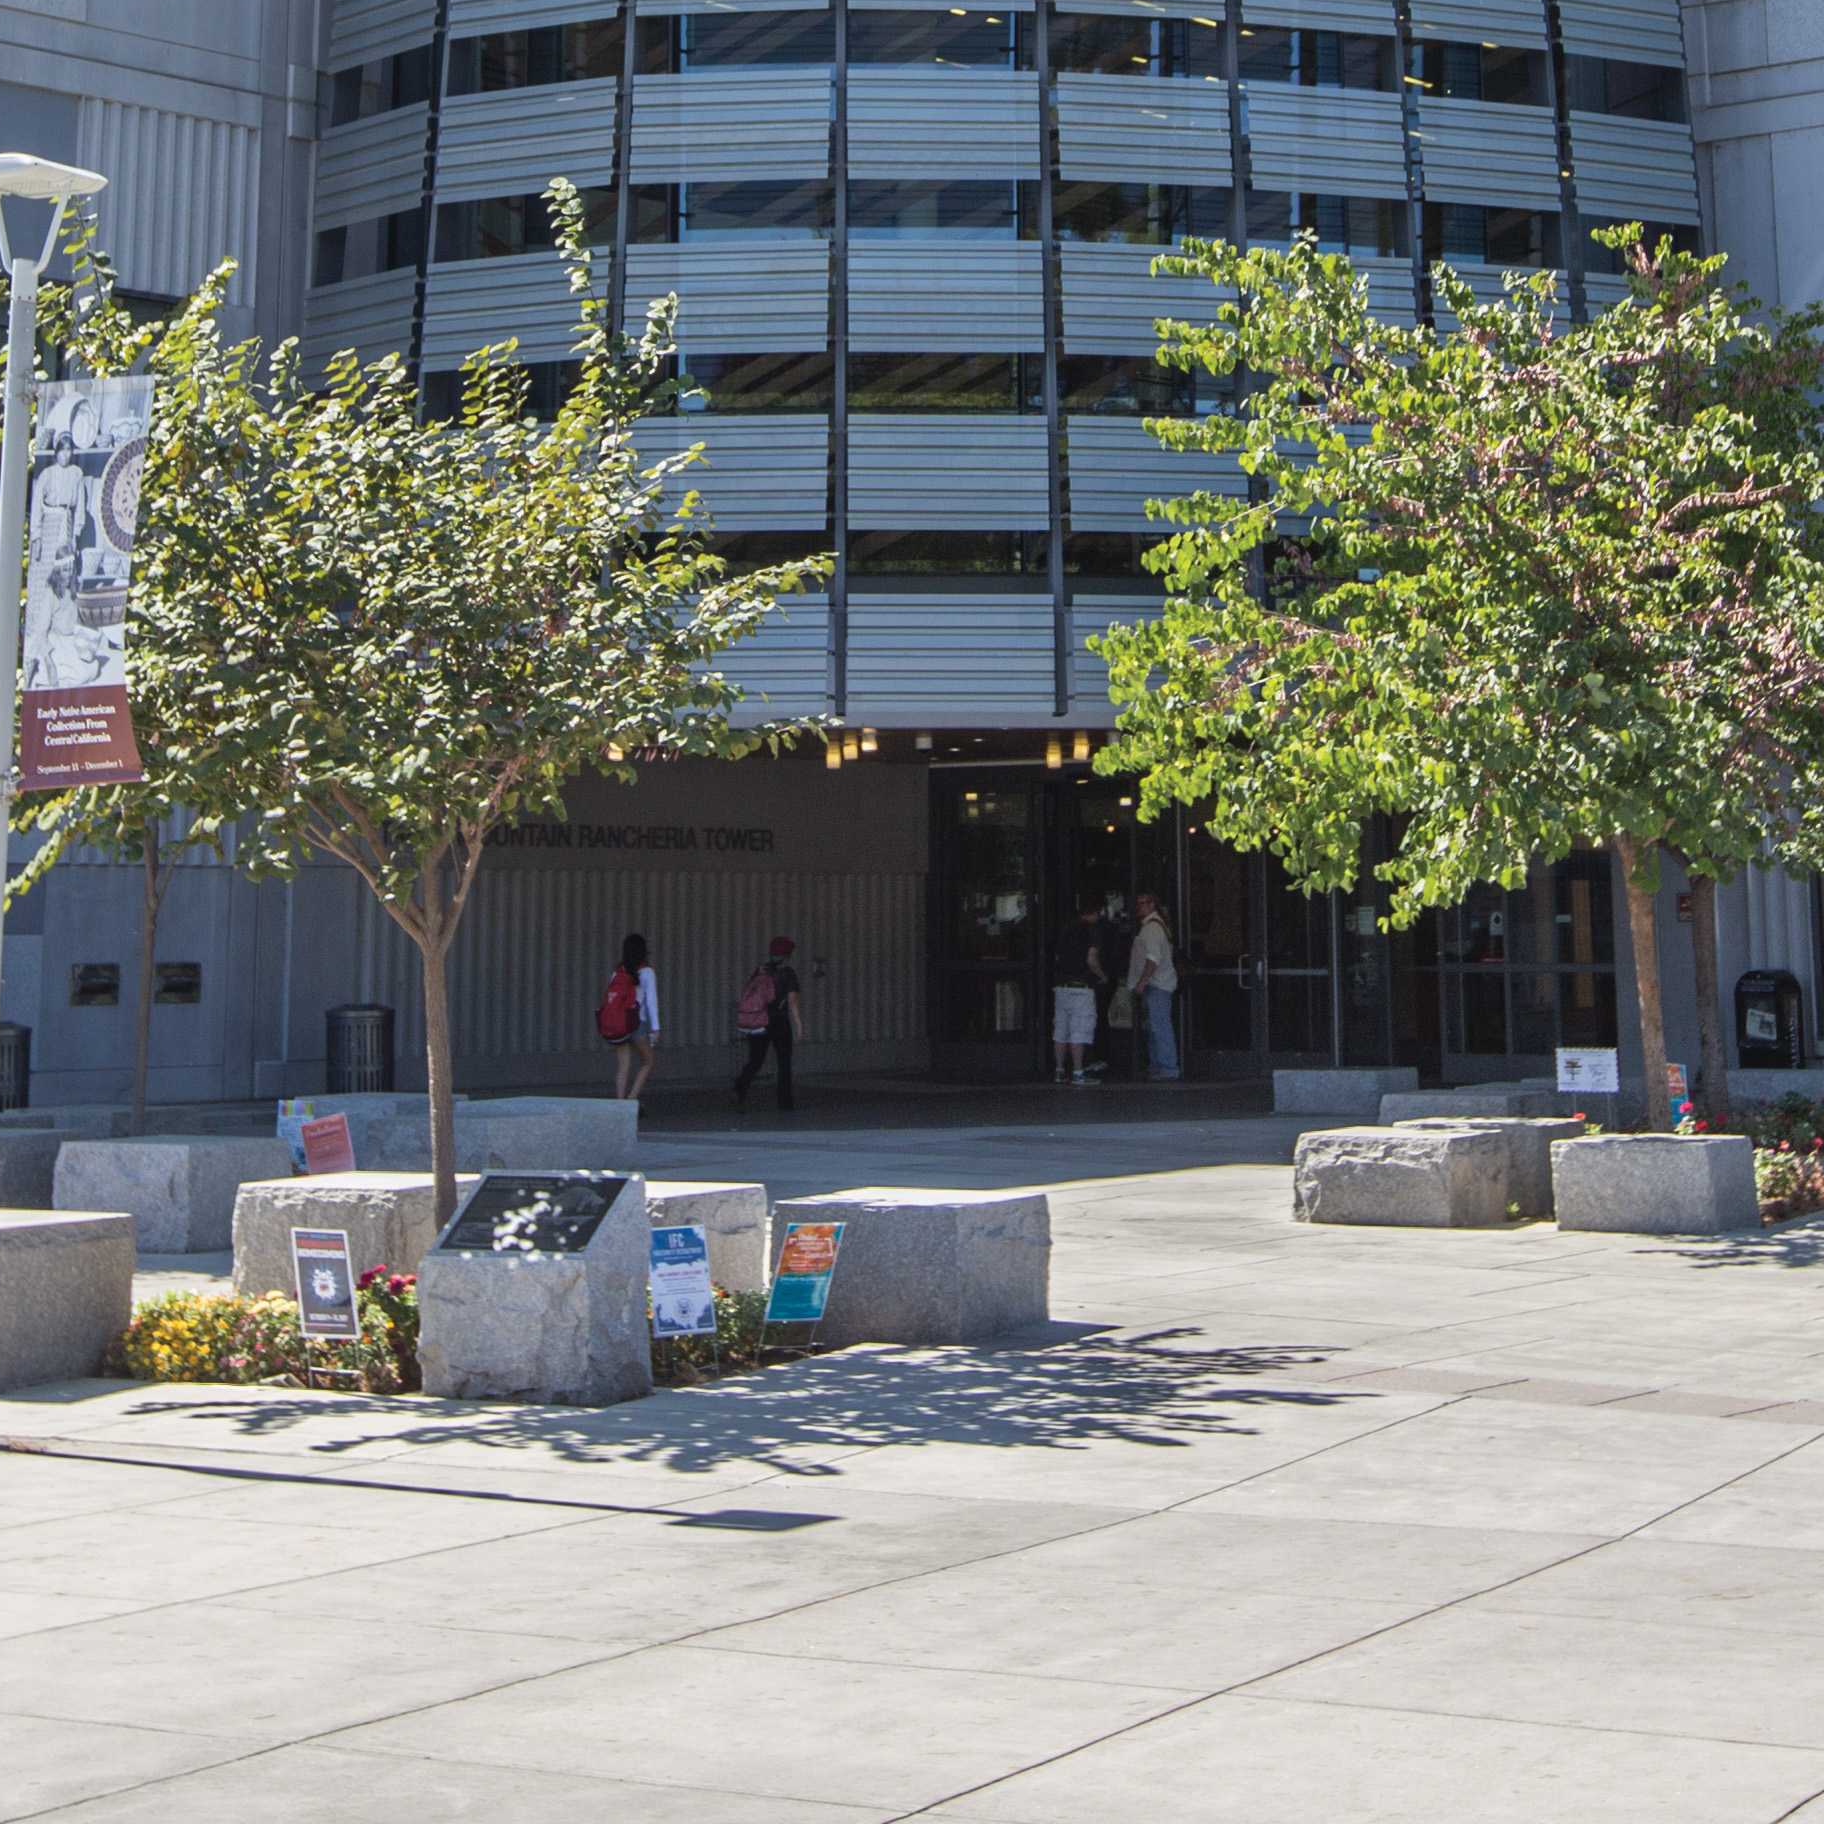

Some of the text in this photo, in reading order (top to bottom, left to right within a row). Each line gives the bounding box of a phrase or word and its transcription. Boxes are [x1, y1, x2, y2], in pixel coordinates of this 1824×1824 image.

[37, 707, 58, 720] Early
[80, 703, 116, 716] American
[86, 718, 108, 729] From
[44, 732, 112, 746] Central California
[37, 763, 71, 775] September
[71, 762, 80, 772] 11
[84, 759, 118, 772] December
[578, 824, 697, 850] RANCHERIA
[702, 828, 774, 852] TOWER
